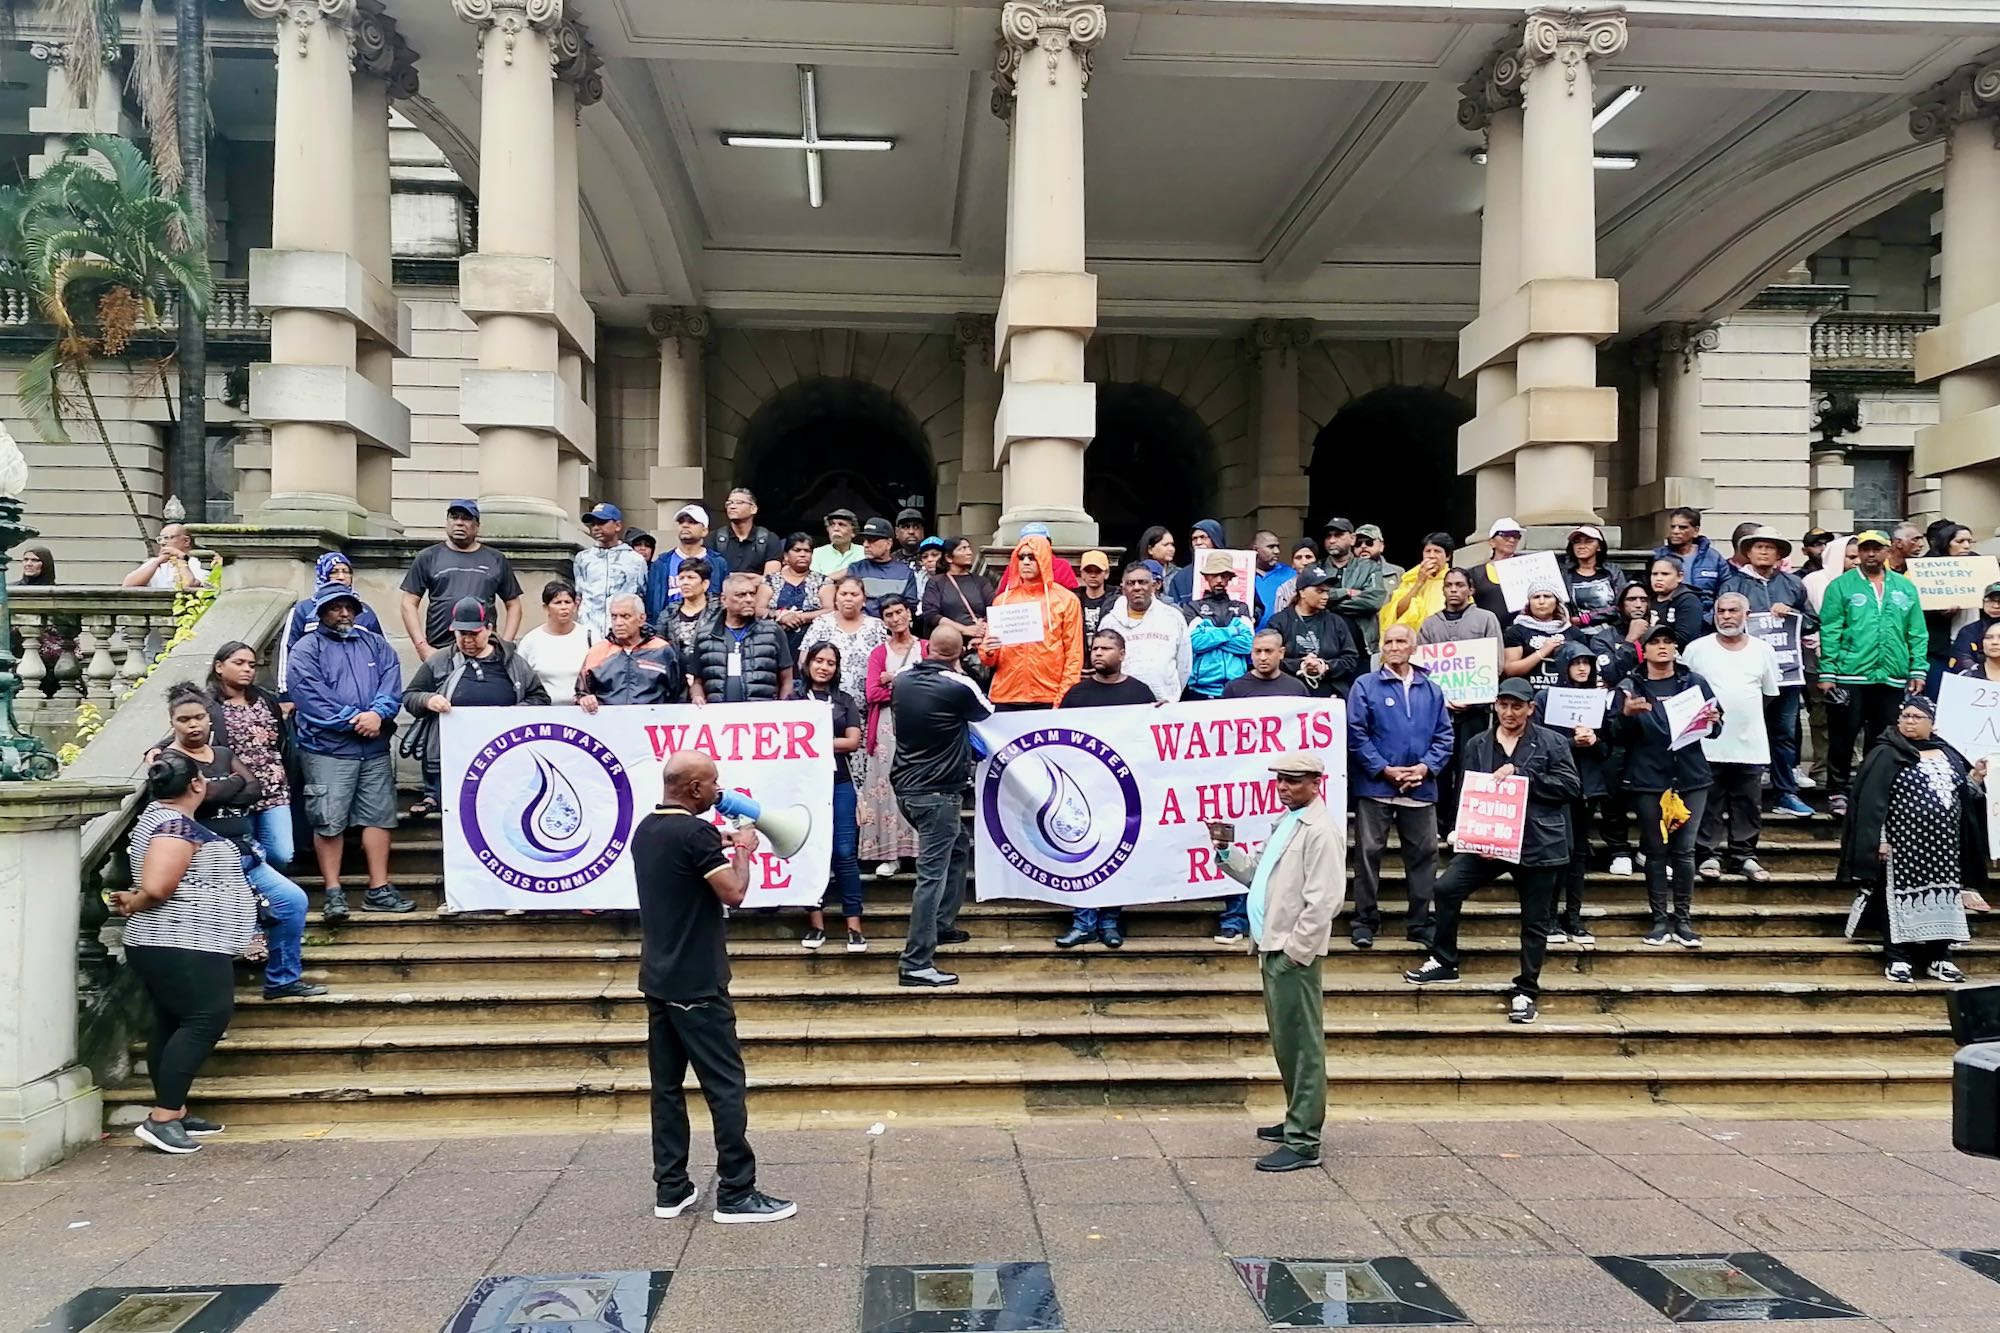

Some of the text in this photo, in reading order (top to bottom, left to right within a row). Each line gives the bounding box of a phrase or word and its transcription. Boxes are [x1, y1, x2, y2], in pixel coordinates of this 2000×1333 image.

[1422, 642, 1456, 659] NO
[1424, 656, 1475, 673] MORE
[1971, 688, 1999, 707] 23
[466, 725, 624, 781] VERULAM WATER
[644, 721, 819, 761] WATER
[988, 730, 1129, 780] VERULAM WATER
[1150, 711, 1333, 761] WATER IS
[1159, 775, 1329, 825] A HUM
[1468, 798, 1516, 818] Paying
[479, 839, 624, 891] CRISIS COMMITTEE
[1000, 841, 1133, 890] CRISIS COMMITTEE
[1456, 839, 1519, 858] Services
